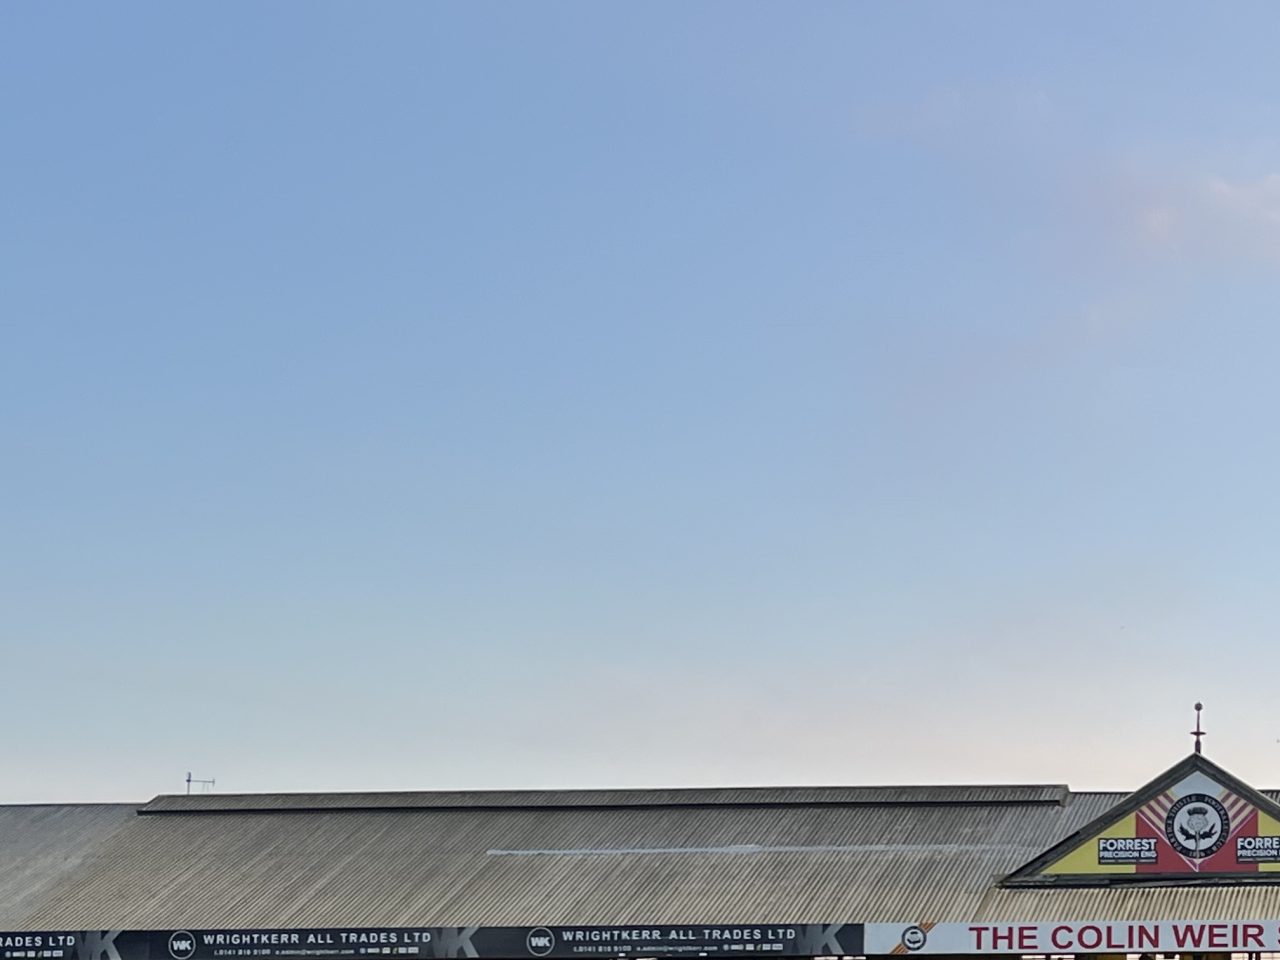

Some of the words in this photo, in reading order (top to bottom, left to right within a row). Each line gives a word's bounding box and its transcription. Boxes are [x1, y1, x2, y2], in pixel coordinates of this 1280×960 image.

[1099, 838, 1157, 850] FORREST
[1237, 849, 1277, 857] PRECISION
[203, 932, 300, 945] WRIGHTKERR
[307, 932, 334, 944] ALL
[340, 932, 398, 944] TRADES
[403, 932, 431, 943] LTD
[562, 930, 662, 941] WRIGHTKERR
[668, 930, 696, 939] ALL
[703, 930, 761, 940] TRADES
[768, 929, 796, 939] LTD
[968, 925, 1039, 950] THE
[1051, 924, 1161, 950] COLIN
[1172, 924, 1265, 948] WEIR
[0, 936, 42, 947] ADES
[48, 936, 76, 946] LTD
